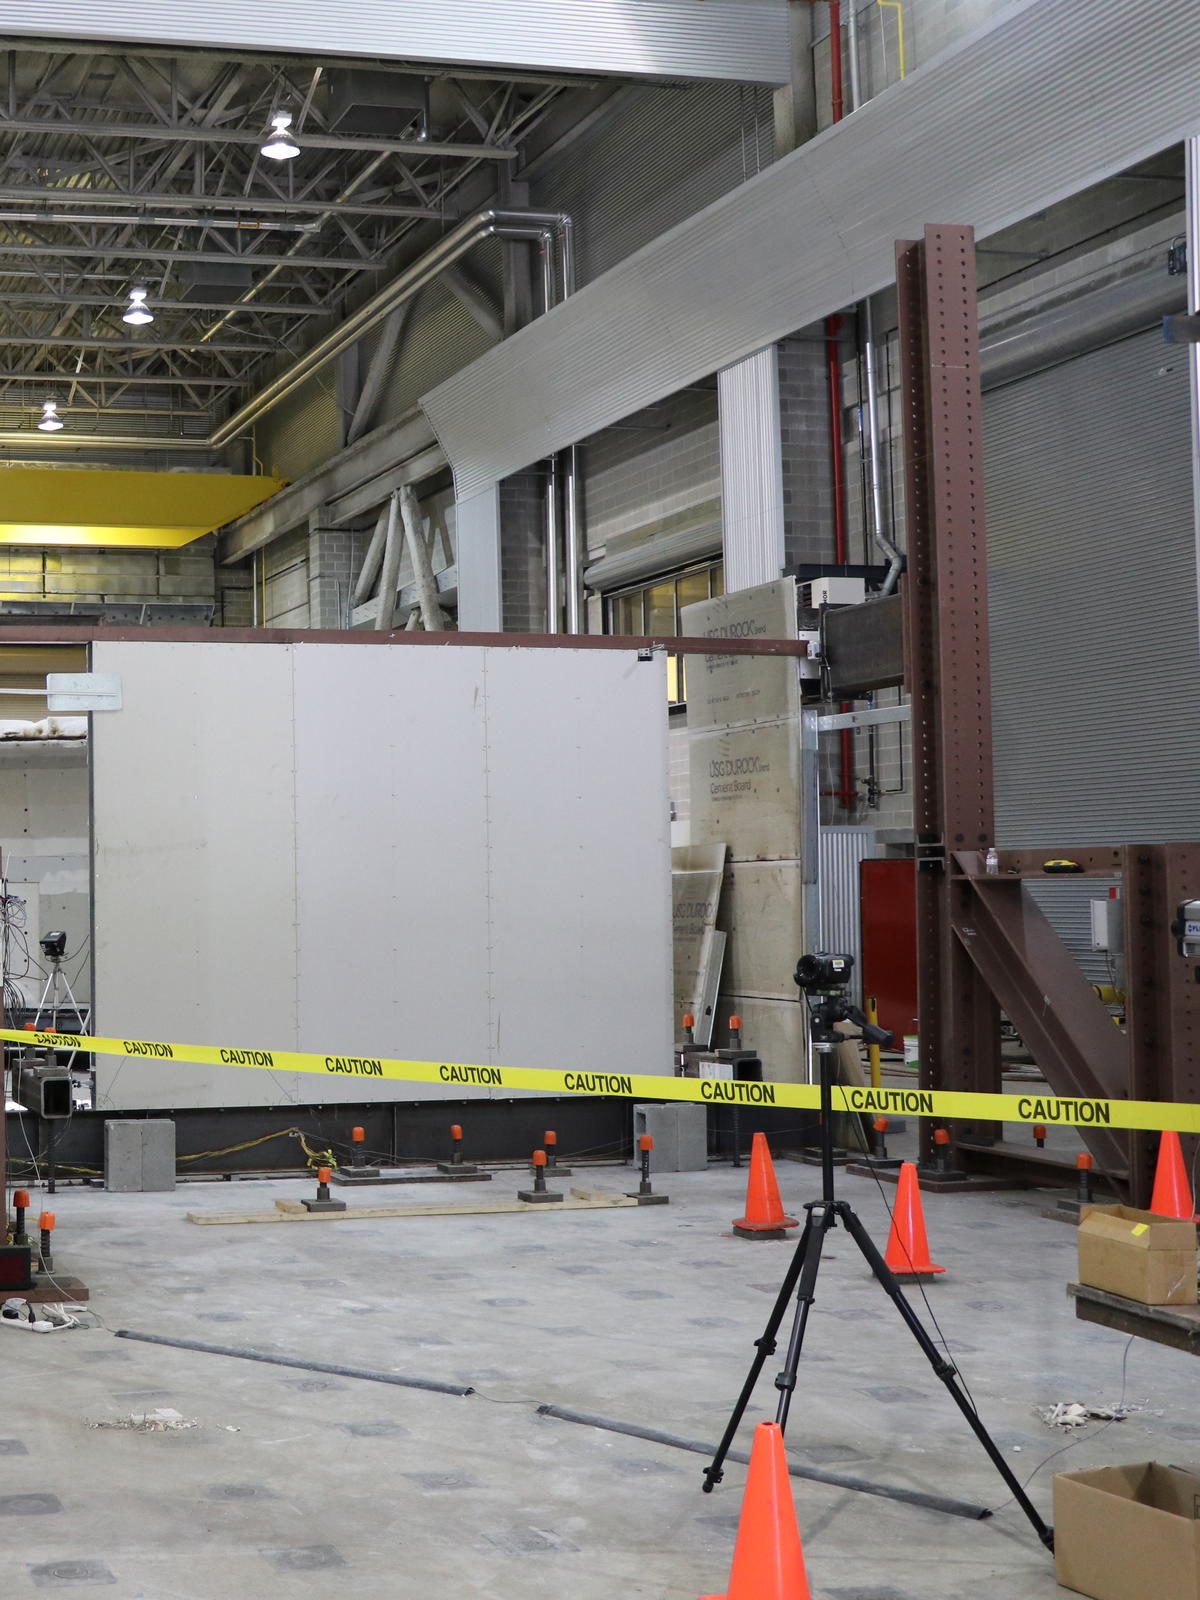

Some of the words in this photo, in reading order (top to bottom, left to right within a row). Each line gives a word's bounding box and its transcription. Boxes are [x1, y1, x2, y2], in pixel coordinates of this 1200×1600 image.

[710, 783, 733, 794] Cement
[734, 779, 752, 792] Board
[36, 1033, 81, 1048] CAUTION
[123, 1040, 174, 1058] CAUTION
[219, 1049, 274, 1067] CAUTION
[325, 1057, 383, 1076] CAUTION
[439, 1065, 503, 1085] CAUTION
[564, 1073, 633, 1094] CAUTION
[701, 1081, 776, 1103] CAUTION
[851, 1089, 934, 1113] CAUTION
[1018, 1098, 1111, 1124] CAUTION
